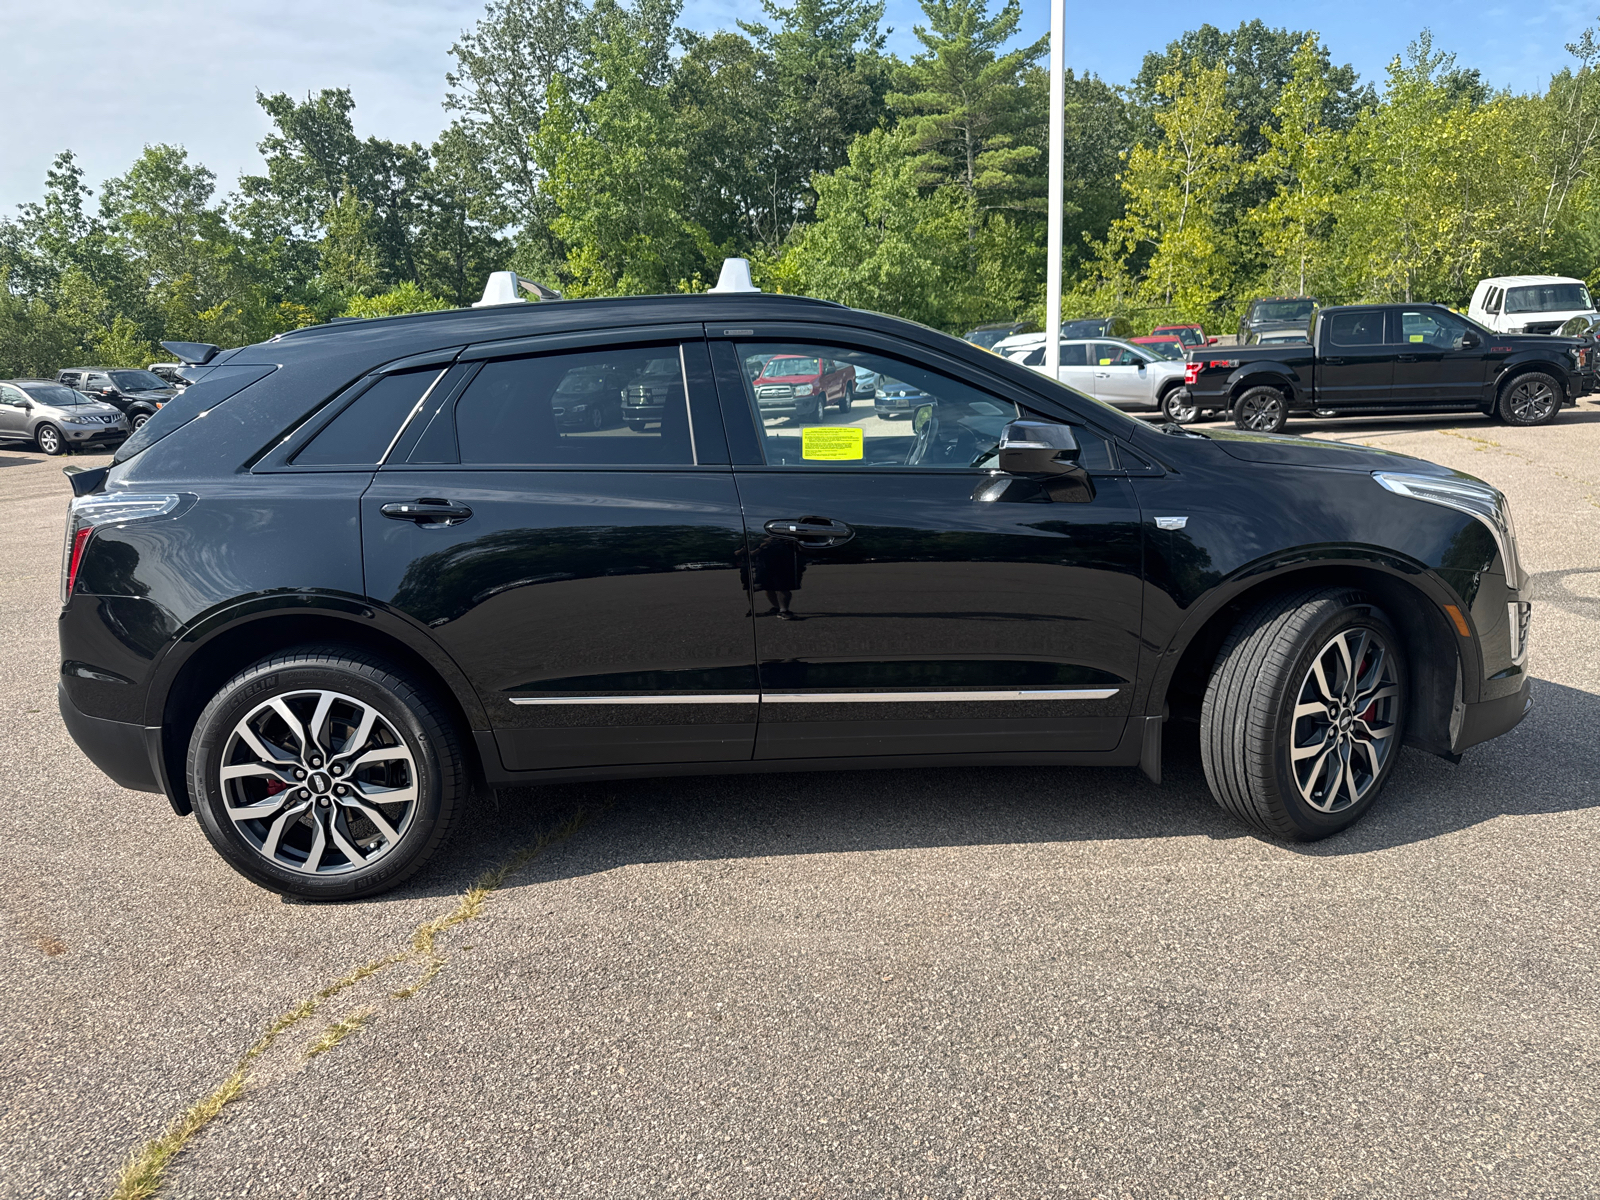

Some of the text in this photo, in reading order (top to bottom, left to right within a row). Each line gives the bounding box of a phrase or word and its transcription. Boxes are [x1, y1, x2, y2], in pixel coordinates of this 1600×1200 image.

[287, 670, 330, 679] PRIMACY
[1286, 643, 1317, 712] MICHELIN
[215, 675, 277, 722] MICHELIN
